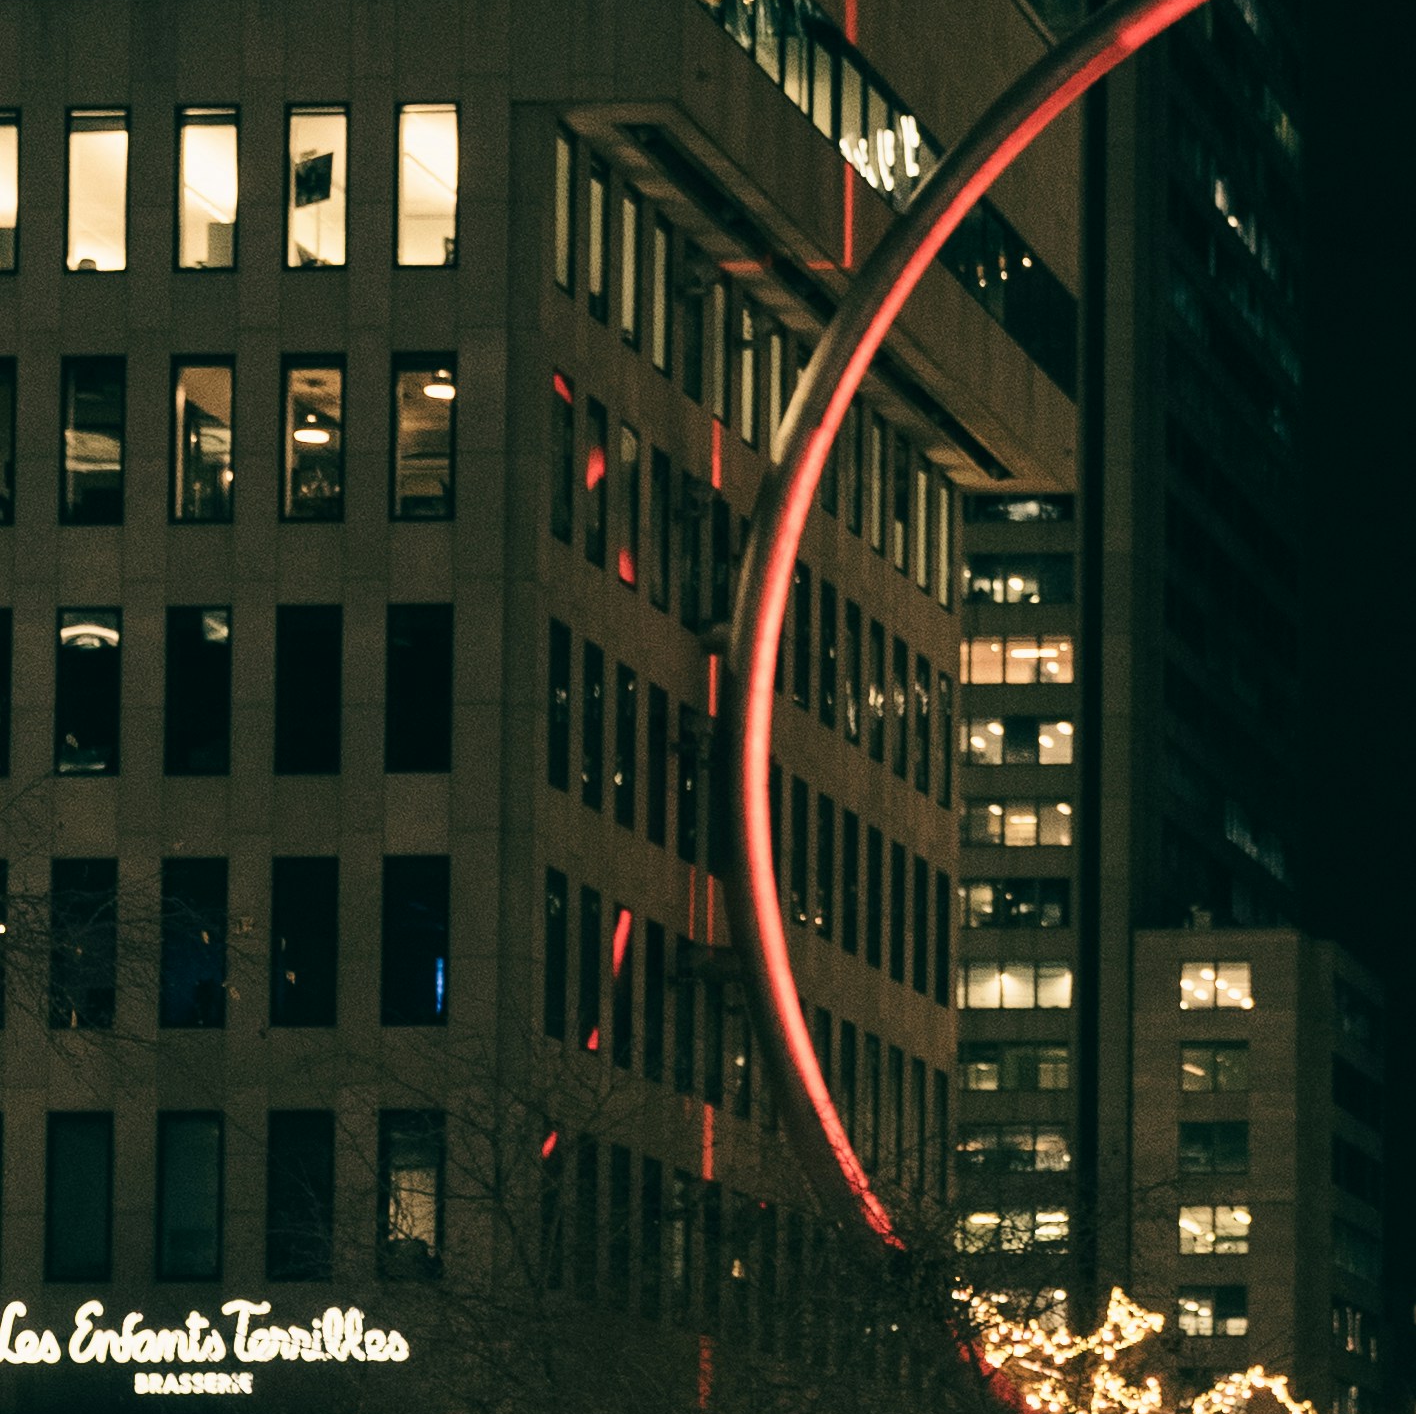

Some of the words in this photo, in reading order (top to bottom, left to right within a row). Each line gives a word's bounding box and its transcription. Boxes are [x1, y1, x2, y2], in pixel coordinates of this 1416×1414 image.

[0, 1301, 61, 1363] Les
[68, 1300, 226, 1363] Enfants
[221, 1299, 409, 1362] Terribles
[134, 1372, 254, 1394] BRASSERIE
